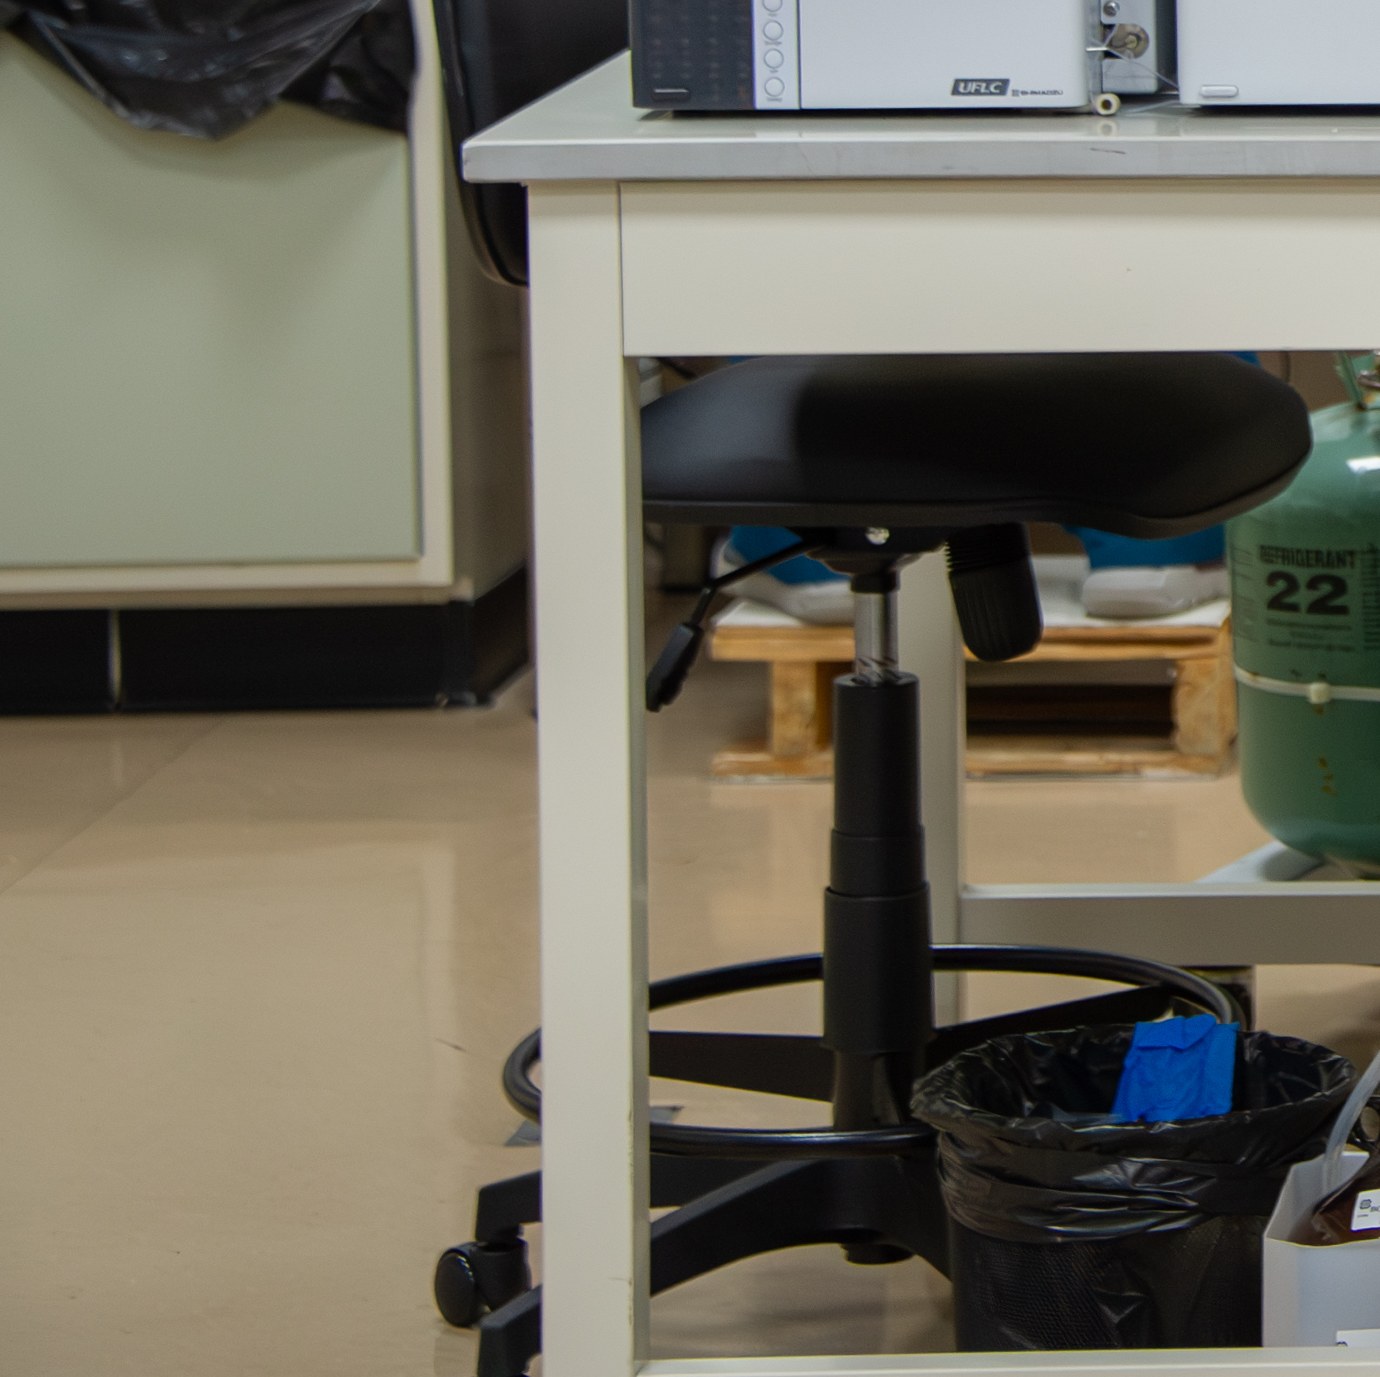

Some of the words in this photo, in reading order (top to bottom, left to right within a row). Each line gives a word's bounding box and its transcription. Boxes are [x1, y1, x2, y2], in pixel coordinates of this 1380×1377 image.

[958, 81, 1002, 93] UFLC
[1260, 545, 1355, 569] REFRIGERANT
[1266, 570, 1350, 615] 22
